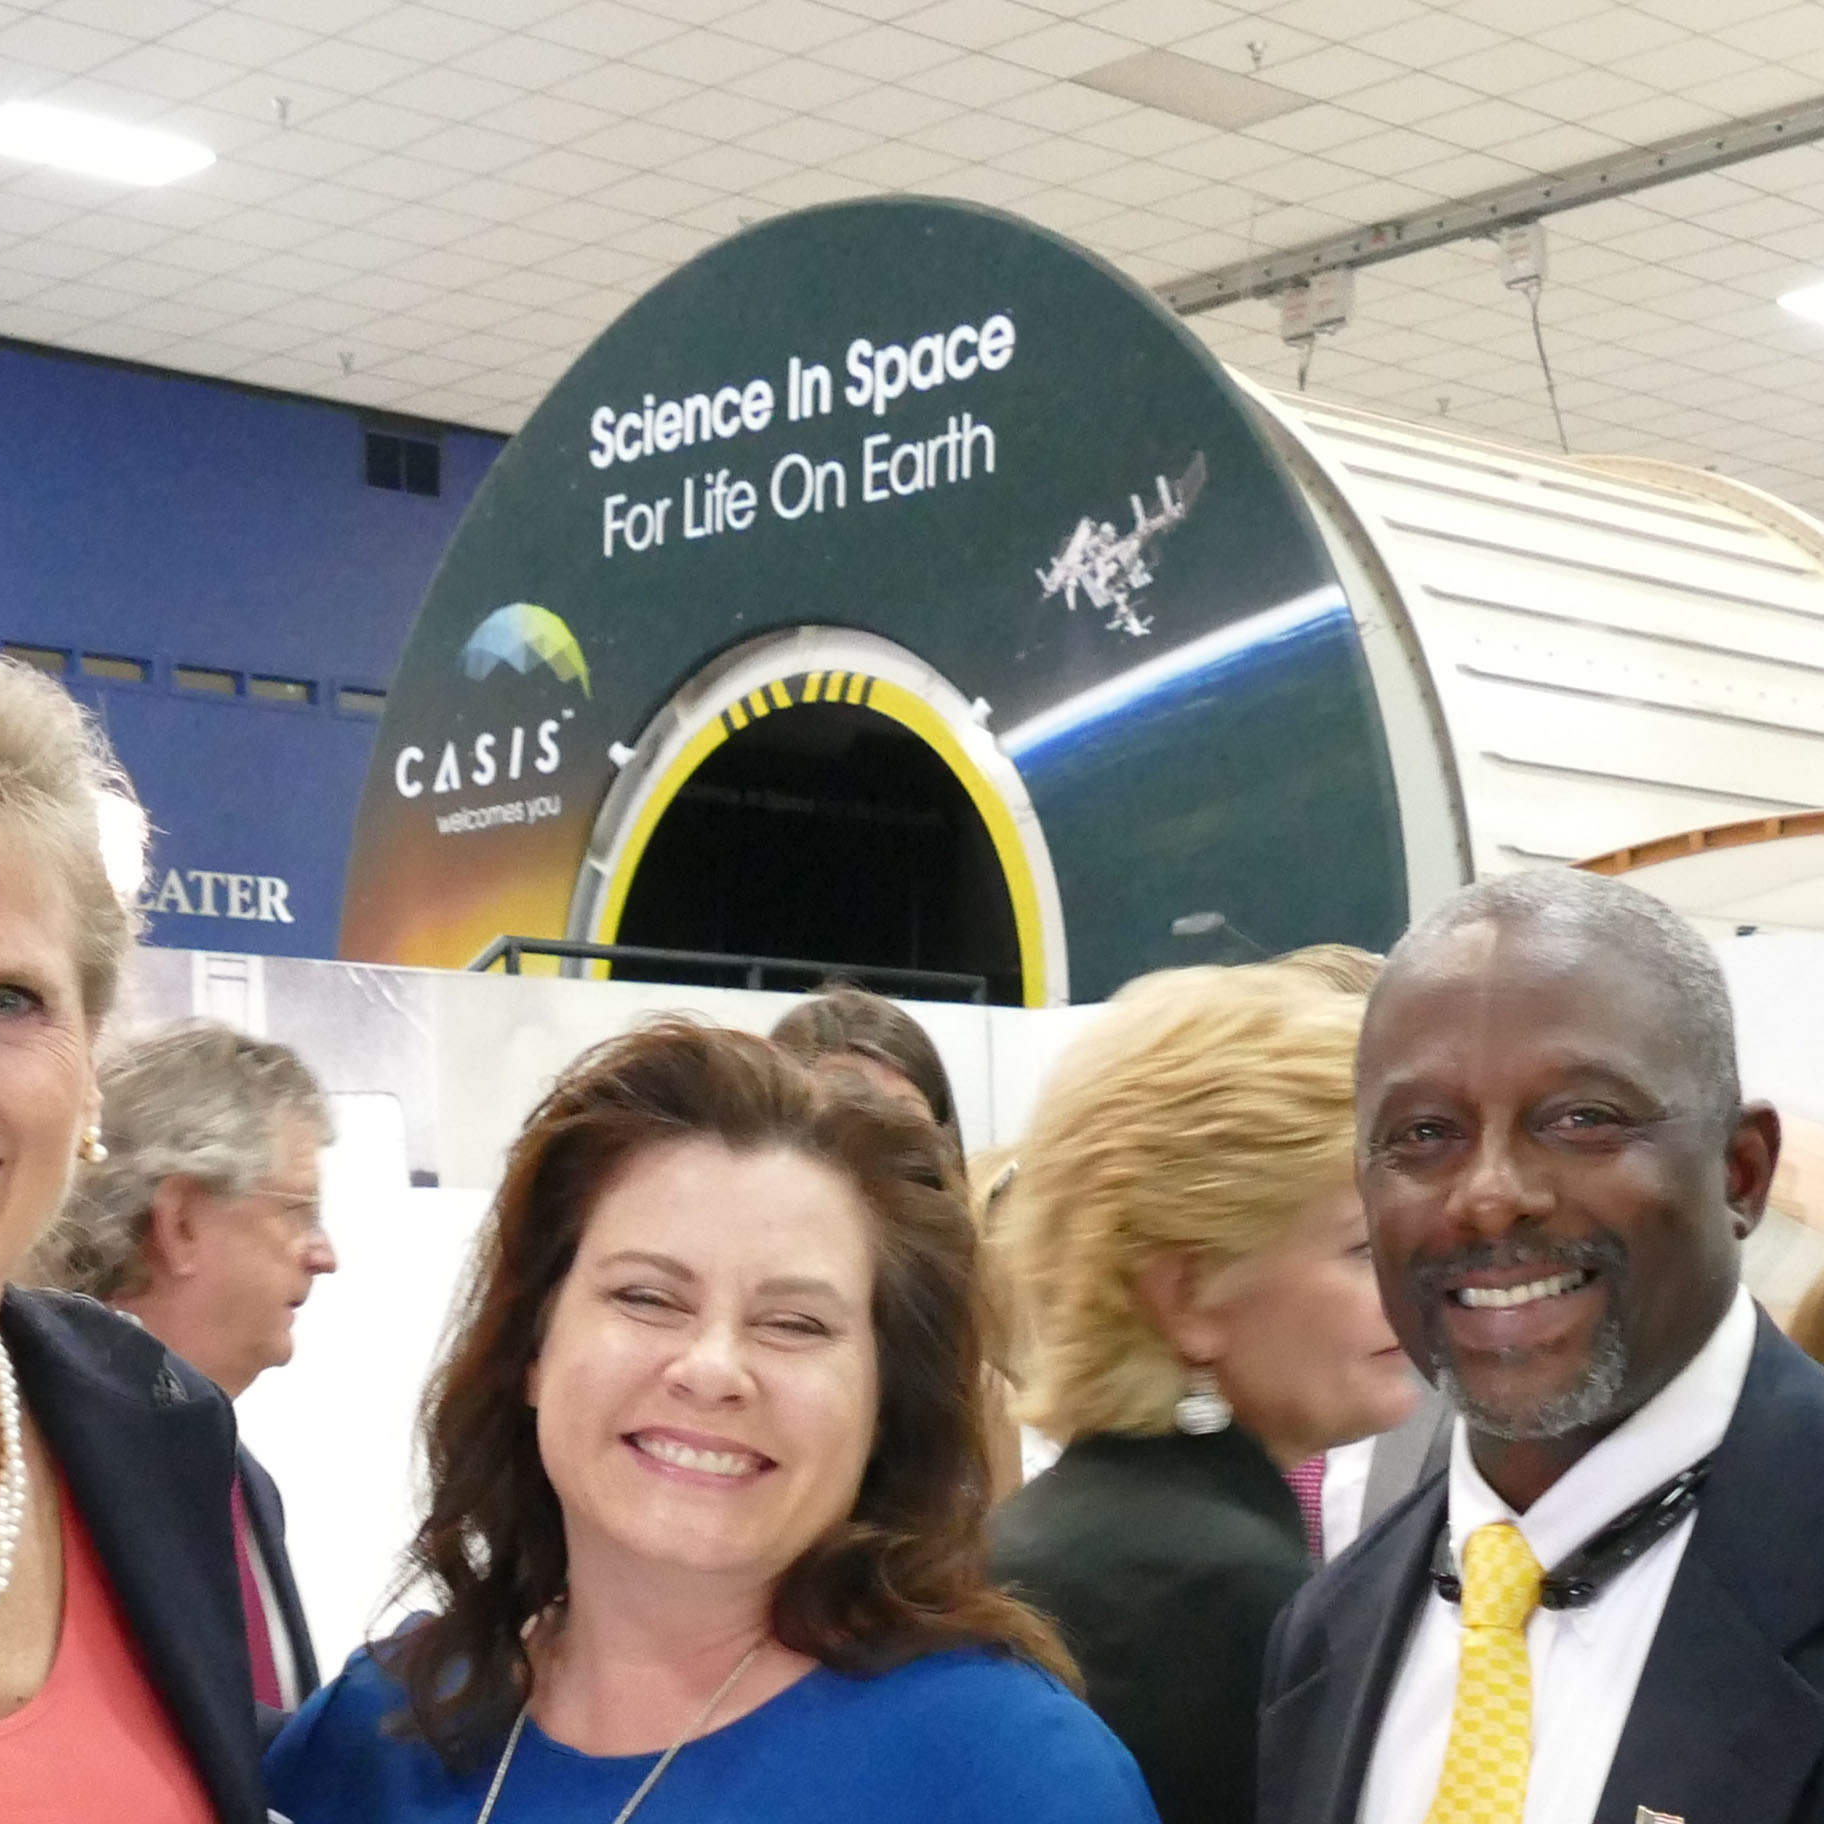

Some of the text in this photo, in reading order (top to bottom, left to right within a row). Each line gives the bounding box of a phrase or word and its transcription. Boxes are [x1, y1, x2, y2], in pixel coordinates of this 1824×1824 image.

[588, 313, 1017, 470] Science In Space
[602, 411, 996, 558] For Life On Earth
[395, 718, 561, 798] CASIS
[436, 794, 562, 834] welcomes you
